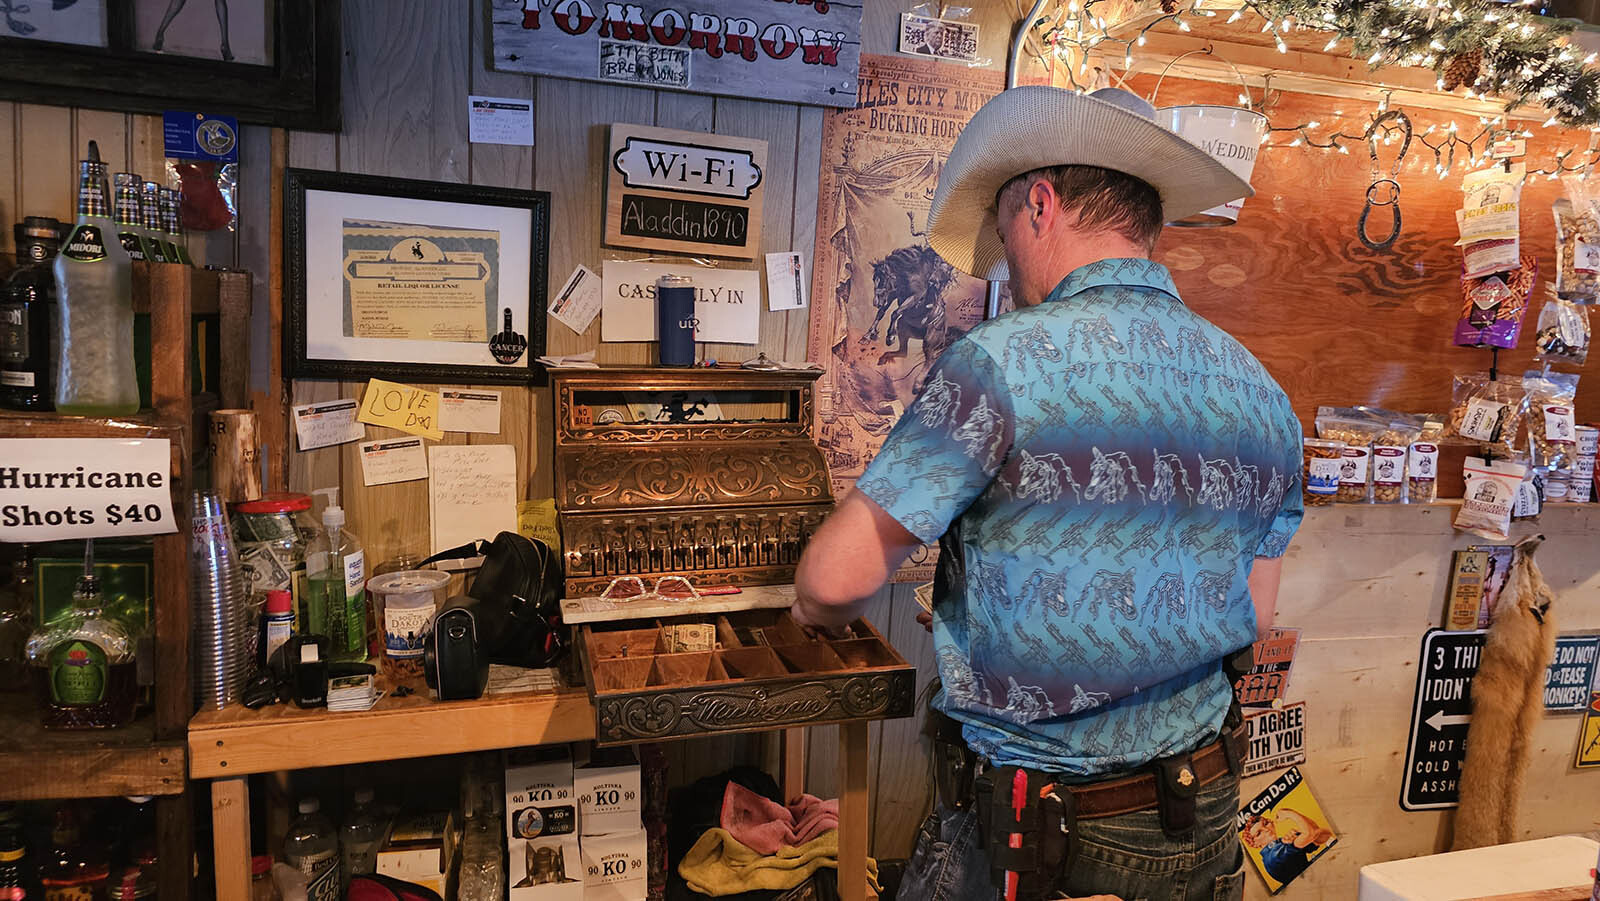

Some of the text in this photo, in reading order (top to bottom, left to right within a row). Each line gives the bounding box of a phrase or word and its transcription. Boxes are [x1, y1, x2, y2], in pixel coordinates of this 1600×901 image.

[513, 0, 847, 66] TOMORROW
[906, 83, 949, 109] CITY
[870, 108, 927, 135] BUCKING
[642, 150, 735, 188] Wi-Fi
[68, 243, 103, 253] MIDORI
[618, 283, 657, 300] CAS
[727, 289, 744, 305] IN
[490, 343, 524, 353] CANCER
[368, 387, 430, 417] LOVE
[578, 408, 587, 416] NO
[0, 466, 163, 489] Hurricane
[2, 503, 162, 527] Shots $40
[391, 617, 430, 629] DAKOTA
[1434, 646, 1484, 671] 3 THI
[1560, 646, 1576, 665] DO
[1574, 646, 1596, 664] NOT
[1262, 663, 1278, 673] THE
[1560, 666, 1587, 685] TEASE
[1425, 677, 1471, 702] I DON'
[1259, 707, 1303, 736] AGREE
[1248, 736, 1271, 761] ITH
[1275, 728, 1304, 753] YOU
[1429, 739, 1454, 753] HOT
[1416, 759, 1450, 774] COLD
[528, 789, 553, 802] KO
[557, 790, 568, 799] 90
[1250, 794, 1272, 814] Can
[1268, 782, 1287, 799] Do
[1284, 767, 1300, 786] It!
[1420, 779, 1456, 793] ASSH
[580, 789, 635, 806] 90 KO 90
[588, 859, 642, 877] 90 KO 90
